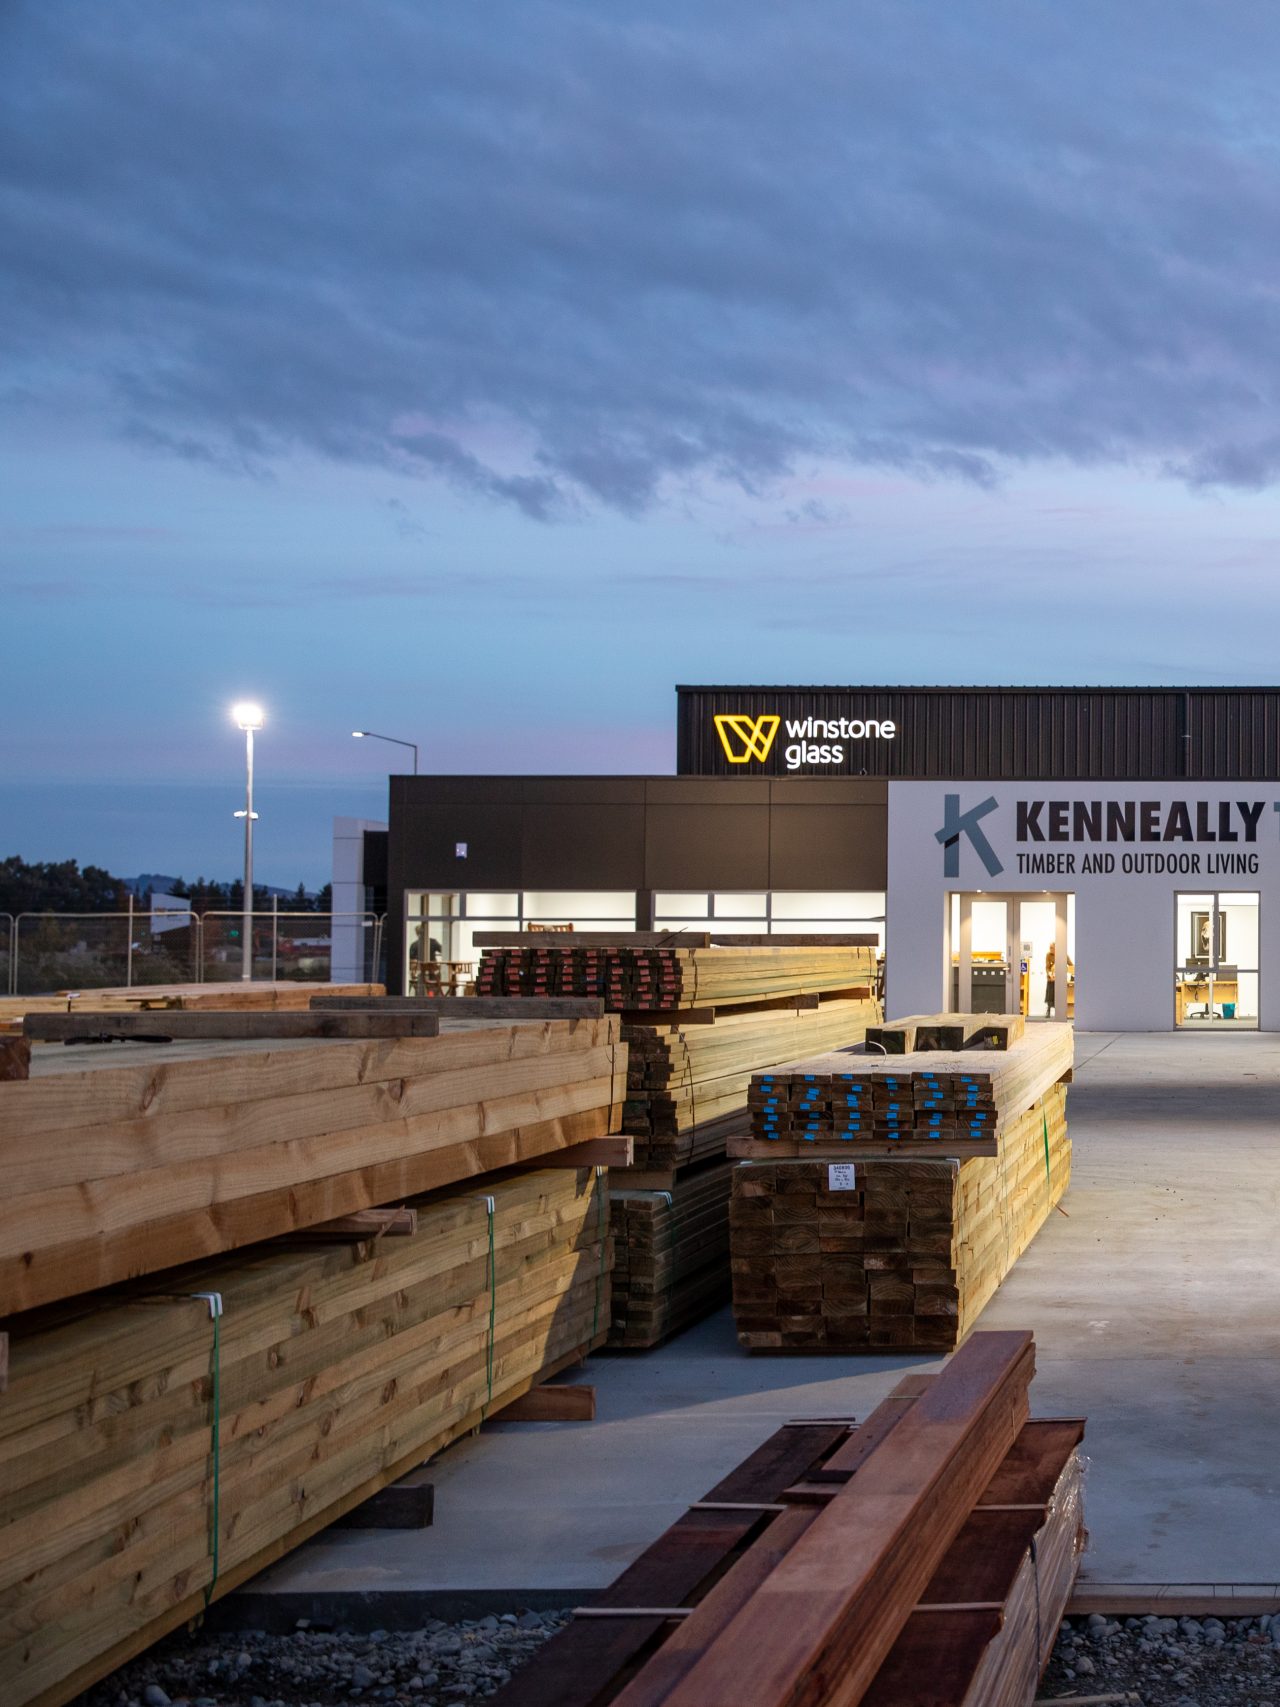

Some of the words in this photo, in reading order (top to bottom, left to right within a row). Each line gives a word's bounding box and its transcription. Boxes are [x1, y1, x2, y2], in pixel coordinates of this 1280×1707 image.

[785, 716, 896, 739] winstone
[785, 740, 844, 769] glass
[934, 794, 1004, 878] K
[1016, 801, 1266, 842] KENNEALLY
[1017, 853, 1076, 874] TIMBER
[1081, 853, 1115, 874] AND
[1121, 853, 1201, 874] OUTDOOR
[1207, 853, 1259, 874] LIVING
